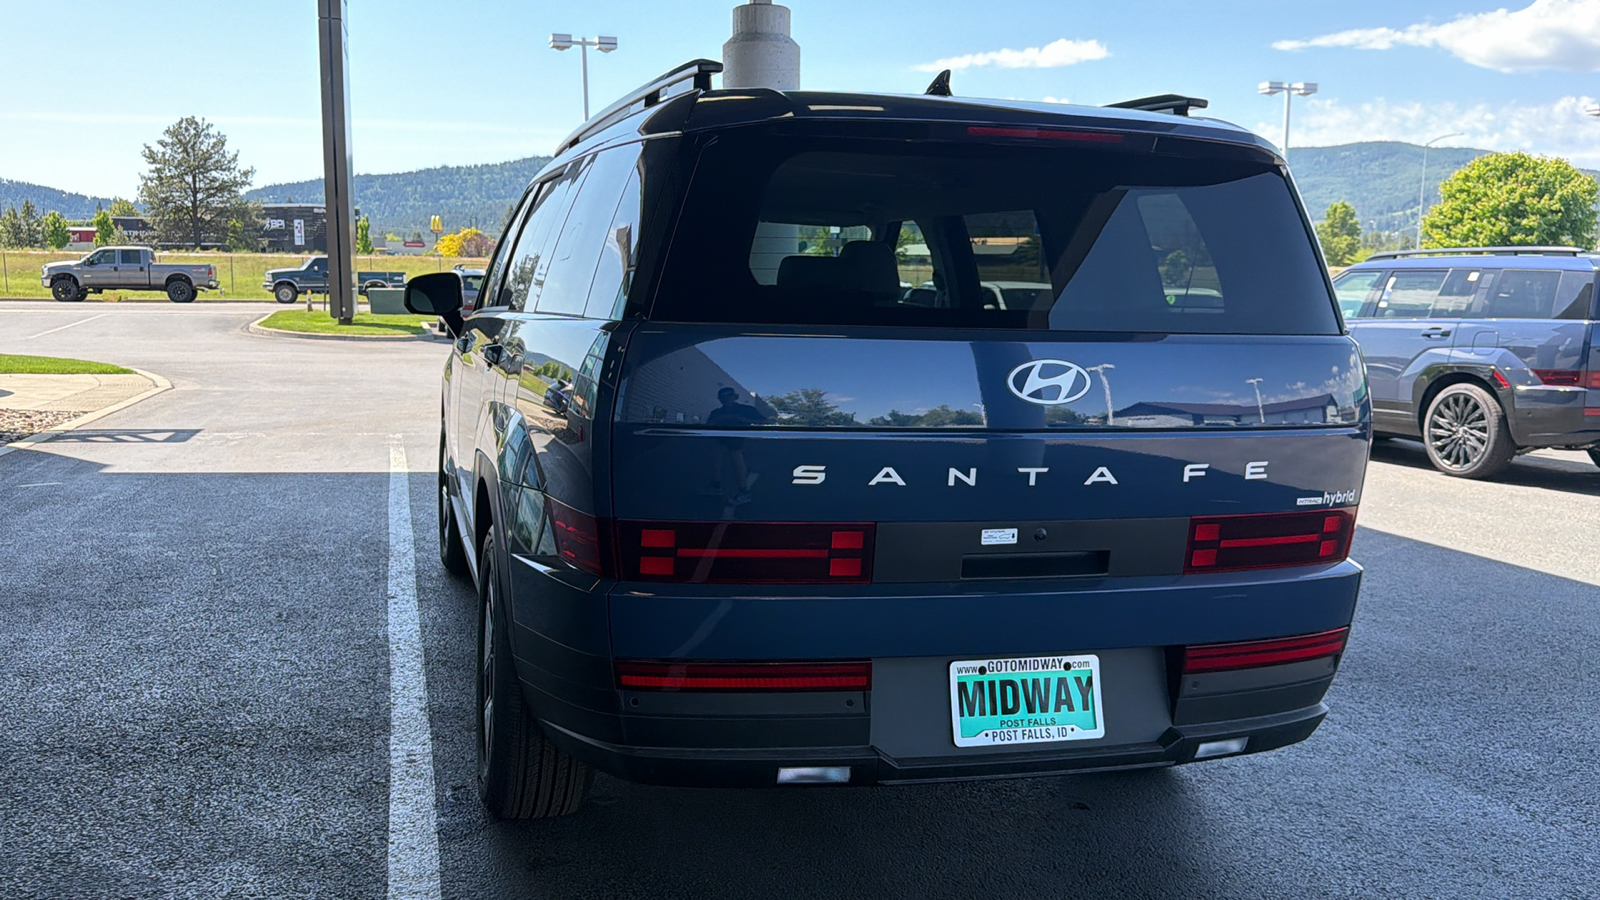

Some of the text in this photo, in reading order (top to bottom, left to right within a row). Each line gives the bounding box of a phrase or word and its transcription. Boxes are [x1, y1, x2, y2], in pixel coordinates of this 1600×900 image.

[791, 460, 1269, 487] SANTA FE
[1323, 489, 1356, 507] hybrid
[957, 676, 1093, 717] MIDWAY
[1000, 717, 1057, 727] POST FALLS
[992, 726, 1068, 742] POST FALLS, ID
